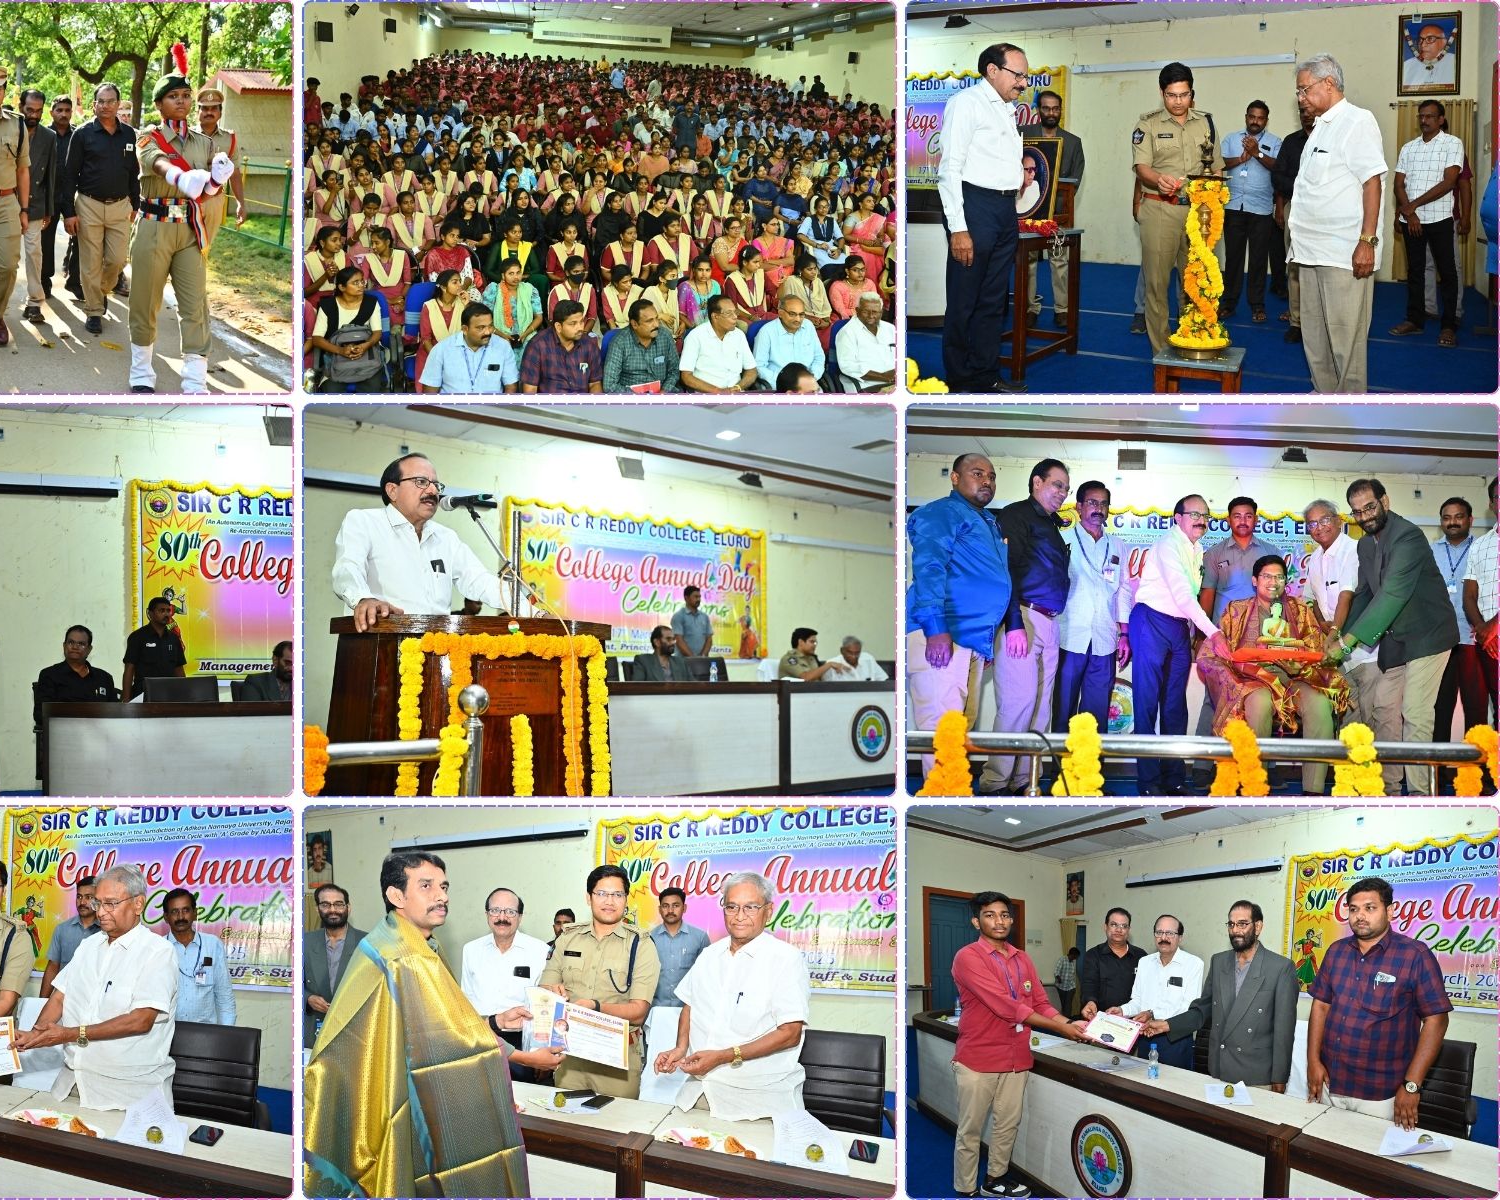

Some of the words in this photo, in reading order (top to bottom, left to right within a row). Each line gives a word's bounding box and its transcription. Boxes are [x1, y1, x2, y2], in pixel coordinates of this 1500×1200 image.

[912, 79, 946, 90] REDDY
[1027, 75, 1051, 86] URU
[177, 494, 212, 513] SIR
[218, 495, 231, 514] C
[239, 496, 252, 515] R
[252, 520, 271, 528] College
[541, 511, 565, 525] SIR
[571, 514, 580, 527] C
[585, 516, 594, 529] R
[600, 518, 644, 535] REDDY
[650, 523, 710, 545] COLLEGE,
[714, 532, 751, 549] ELURU
[1114, 516, 1124, 527] C
[158, 531, 201, 562] 80th
[555, 546, 633, 592] College
[640, 555, 711, 589] Annual
[718, 563, 756, 601] Day
[41, 813, 70, 831] SIR
[77, 811, 88, 828] C
[95, 809, 107, 826] R
[114, 806, 182, 825] REDDY
[184, 824, 206, 832] Adikavi
[238, 820, 273, 828] University,
[634, 823, 662, 842] SIR
[668, 822, 680, 839] C
[687, 821, 698, 837] R
[705, 814, 773, 836] REDDY
[780, 806, 895, 830] COLLEGE,
[23, 847, 59, 875] 80th
[764, 850, 896, 893] Annual
[1322, 859, 1347, 874] SIR
[1353, 857, 1364, 871] C
[1370, 855, 1382, 869] R
[1388, 846, 1456, 868] REDDY
[1305, 887, 1338, 911] 80th
[809, 971, 839, 981] taff
